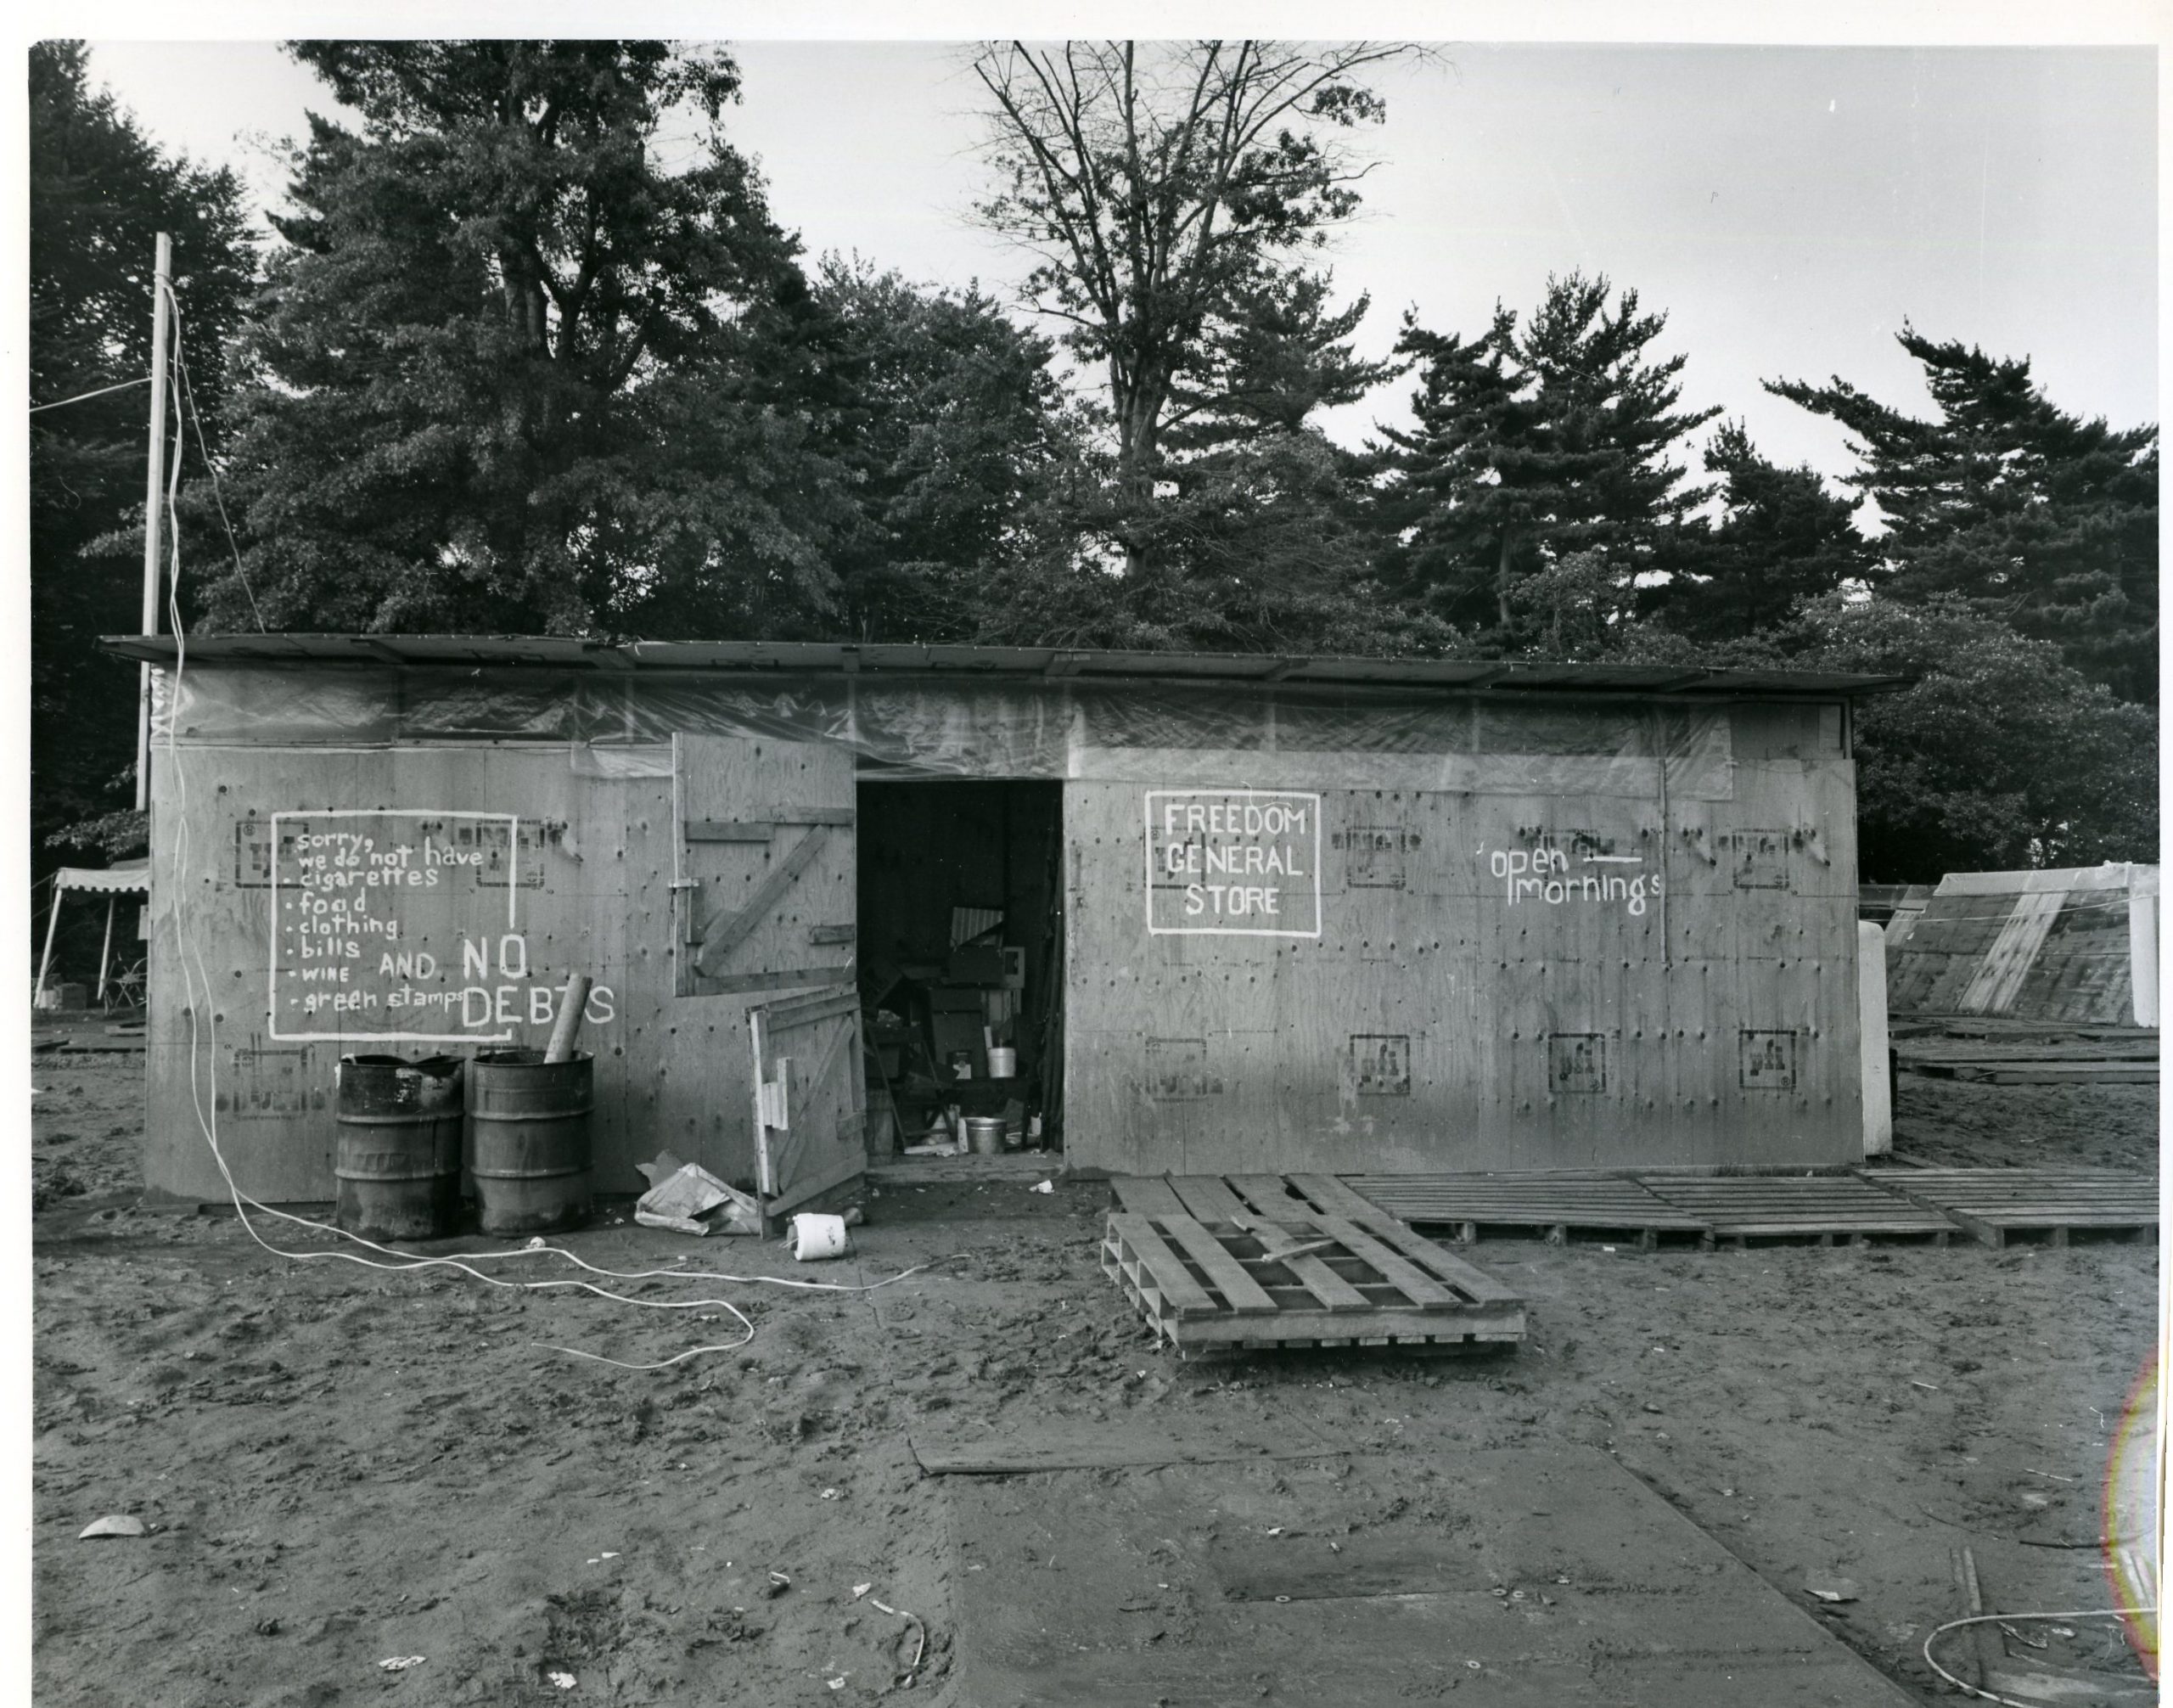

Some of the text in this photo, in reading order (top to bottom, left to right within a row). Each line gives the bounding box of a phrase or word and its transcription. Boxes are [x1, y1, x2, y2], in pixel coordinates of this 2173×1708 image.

[1165, 803, 1305, 835] FREEDOM
[297, 833, 373, 856] sorry,
[298, 854, 328, 870] we
[334, 847, 361, 868] do
[370, 845, 413, 868] not
[425, 836, 484, 866] have
[1167, 842, 1304, 876] GENERAL
[300, 866, 439, 891] cigarettes
[1491, 848, 1569, 907] open
[1185, 883, 1280, 916] STORE
[1515, 874, 1661, 916] mornings
[299, 911, 398, 940] clothing
[301, 935, 361, 958] bills
[379, 934, 527, 980] AND NO
[303, 983, 463, 1014] green stamps
[463, 985, 615, 1028] DEBS
